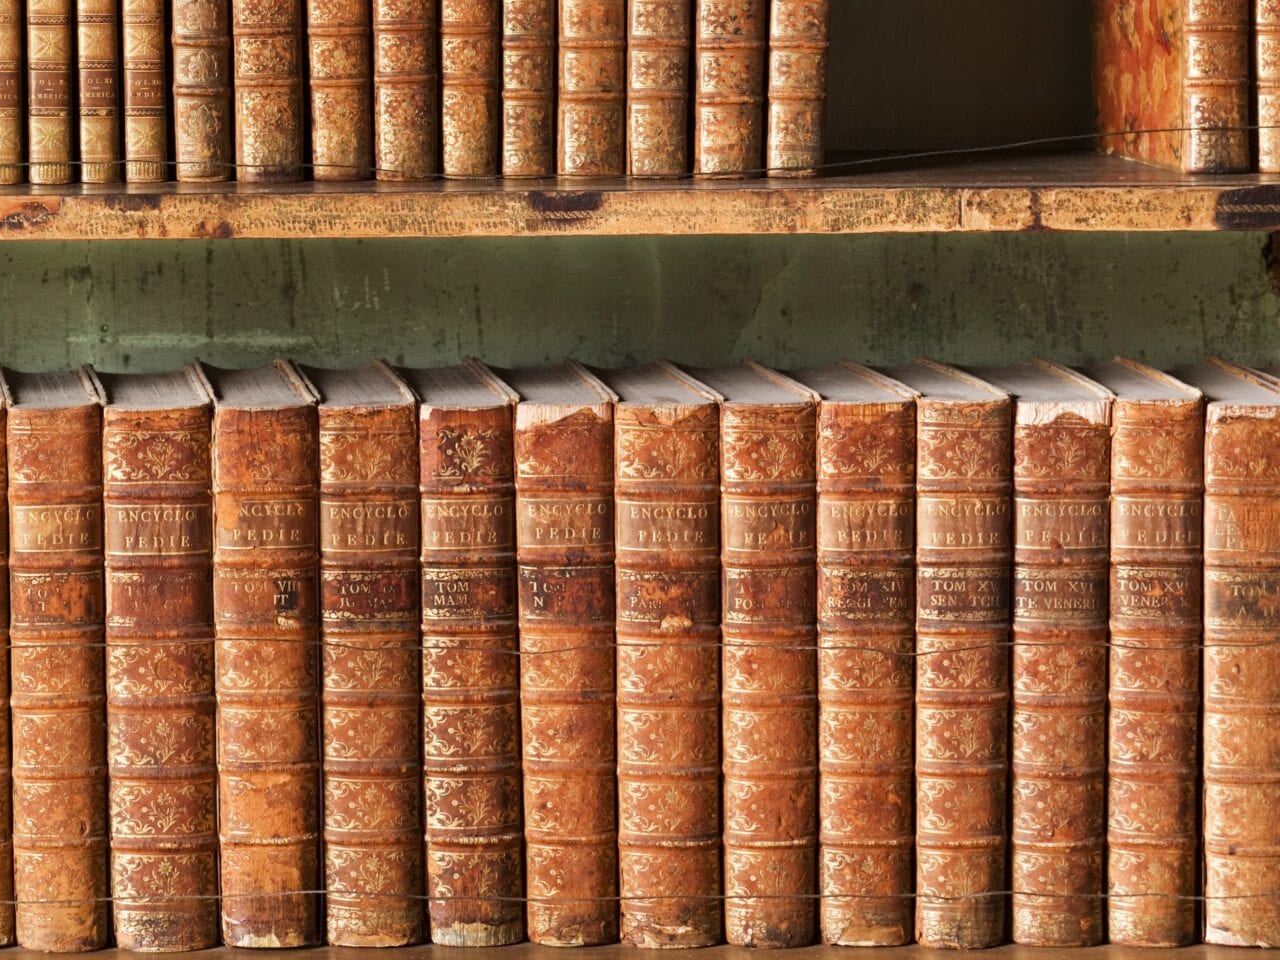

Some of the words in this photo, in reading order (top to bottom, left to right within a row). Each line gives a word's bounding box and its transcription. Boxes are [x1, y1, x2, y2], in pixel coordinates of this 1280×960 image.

[16, 509, 96, 523] ENCYCLO
[118, 509, 196, 522] ENCYCLO
[238, 503, 306, 517] NCYCLO
[329, 506, 410, 519] ENCYCLO
[426, 503, 504, 518] ENCYCLO
[527, 502, 607, 516] ENCYCLO
[630, 505, 708, 520] ENCYCLO
[734, 502, 809, 518] ENCYCLO
[831, 504, 909, 518] ENCYCLO
[926, 503, 1007, 517] ENCYCLO
[1022, 503, 1101, 517] ENCYCLO
[1120, 504, 1197, 517] ENCYCLO
[23, 532, 90, 545] PEDIE
[232, 528, 300, 542] PEDIE
[332, 533, 406, 546] PEDIE
[432, 531, 497, 544] PEDIE
[535, 527, 602, 540] PEDIE
[638, 530, 704, 542] PEDIE
[837, 529, 903, 543] PEDIE
[931, 532, 999, 545] PEDIE
[1025, 528, 1100, 543] PEDIE
[125, 535, 192, 548] PEDIE
[1021, 580, 1057, 592] TOM
